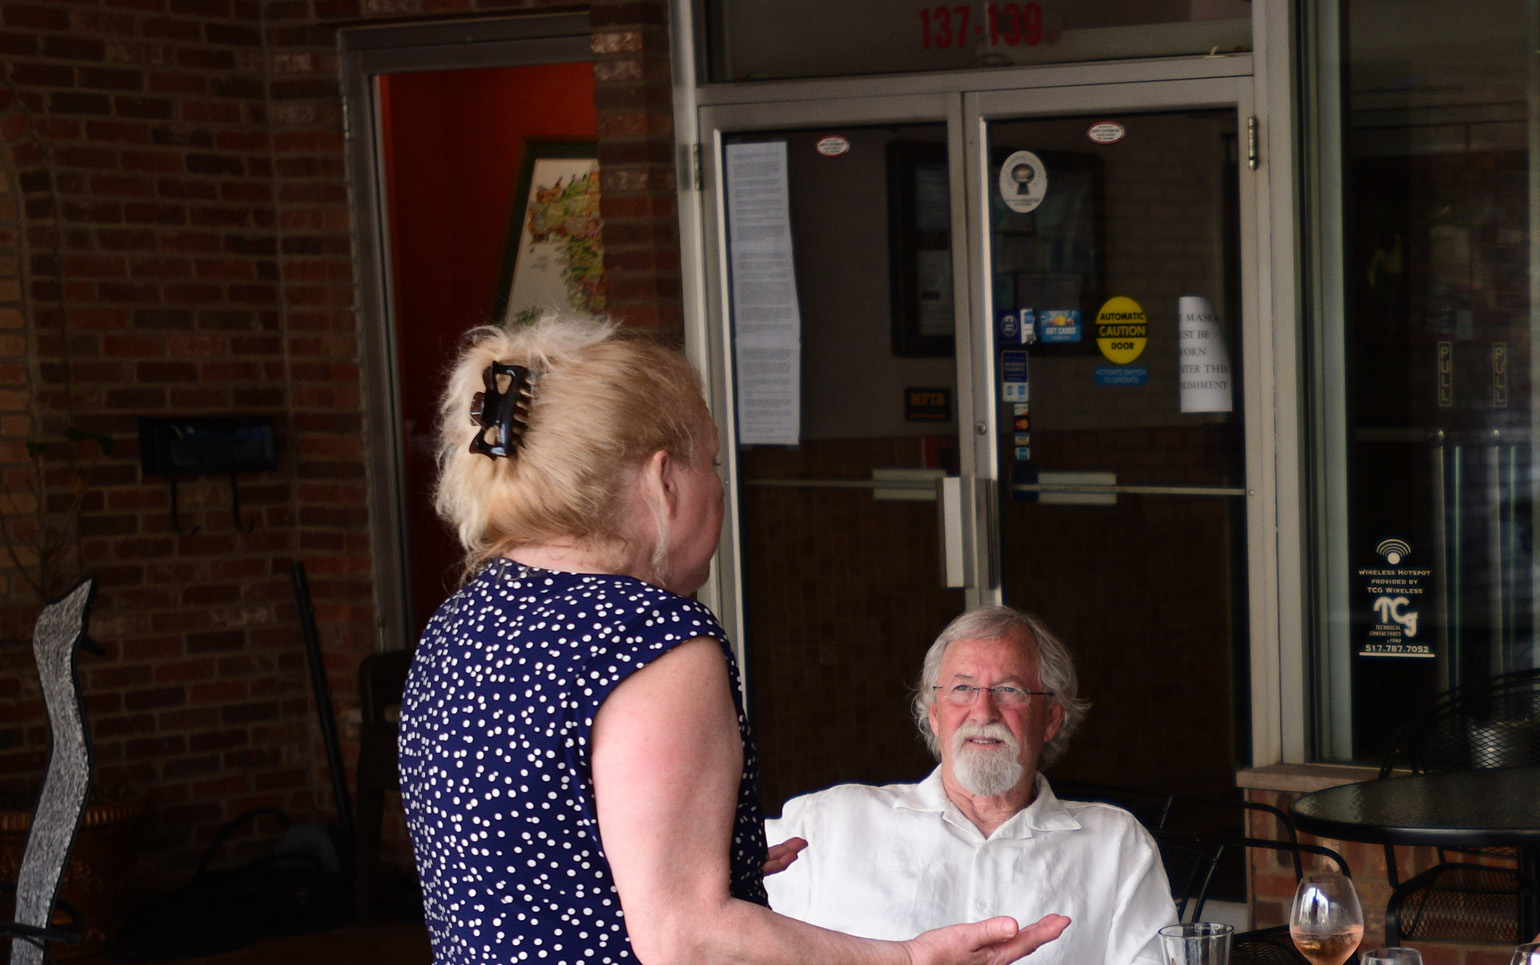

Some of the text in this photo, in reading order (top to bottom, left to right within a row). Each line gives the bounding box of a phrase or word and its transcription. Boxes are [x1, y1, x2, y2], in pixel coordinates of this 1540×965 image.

[1100, 312, 1144, 320] AUTOMATIC
[1099, 325, 1146, 337] CAUTION
[1197, 330, 1210, 339] BE
[1110, 342, 1135, 350] DOOR
[1179, 363, 1230, 374] NTER THIS
[1365, 644, 1430, 653] 517.787.7052
